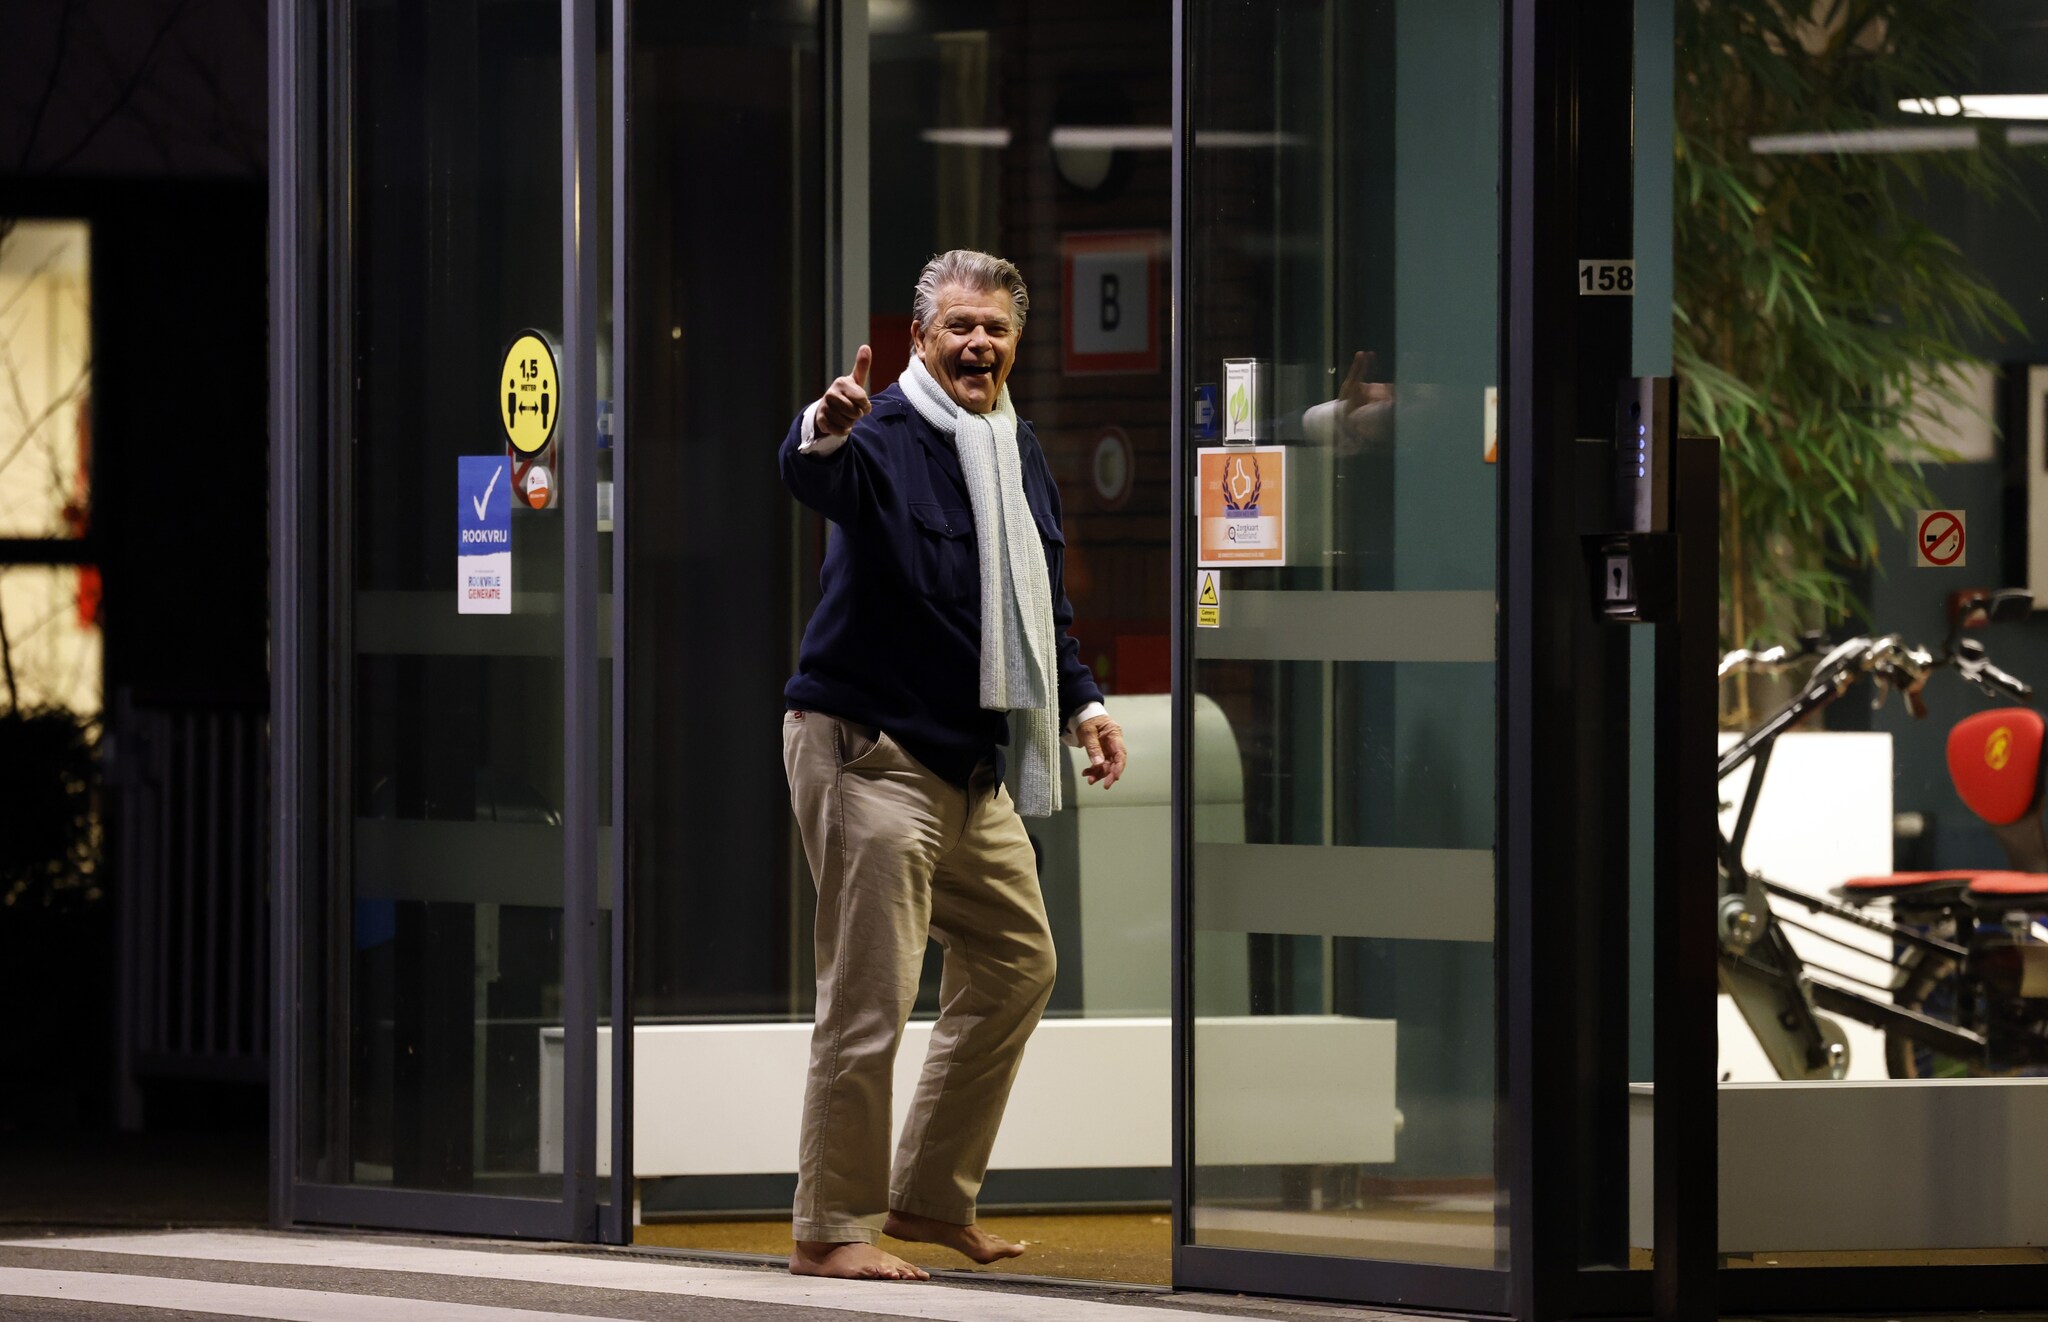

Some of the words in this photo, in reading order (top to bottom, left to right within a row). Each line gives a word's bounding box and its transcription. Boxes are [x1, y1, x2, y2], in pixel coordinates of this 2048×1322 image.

[1581, 265, 1633, 291] 158
[1101, 273, 1120, 332] B
[519, 359, 538, 381] 1,5
[462, 529, 507, 543] ROOKVRIJ
[1236, 524, 1259, 533] Zorgkaart
[468, 588, 500, 599] GENERATIE
